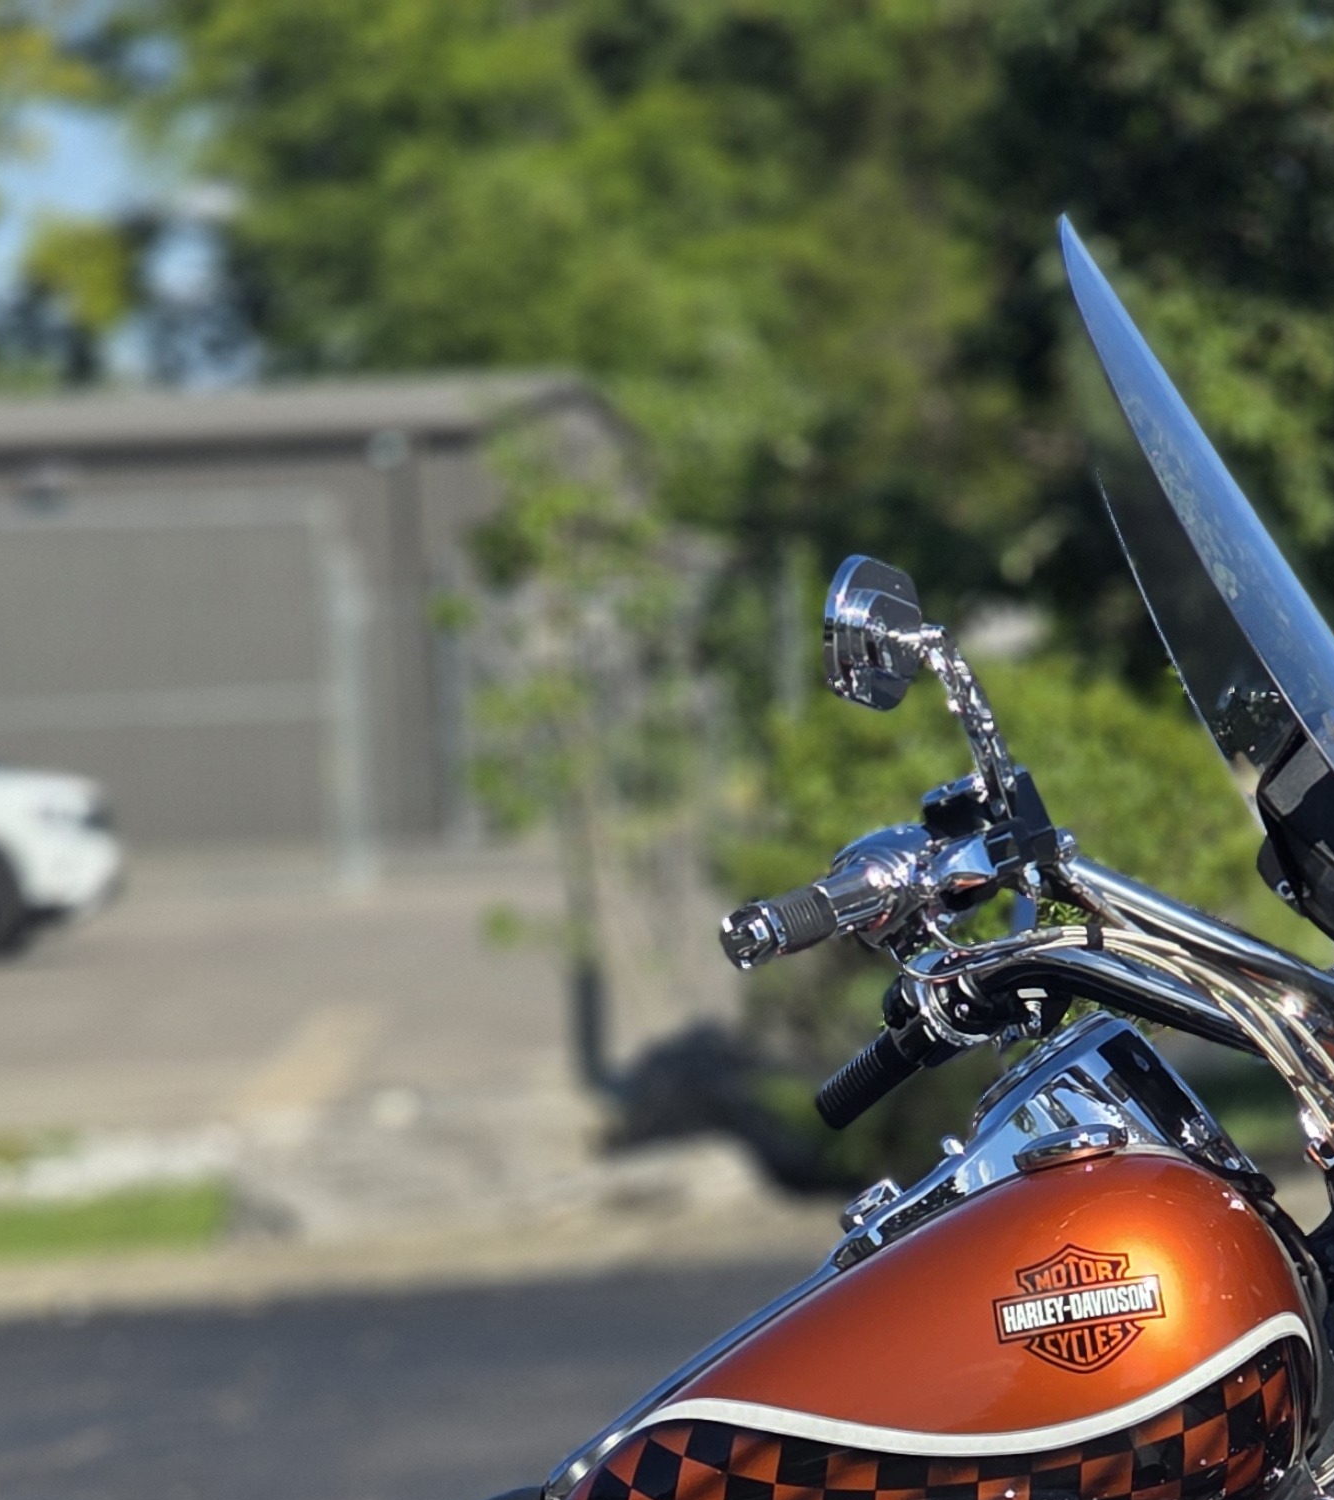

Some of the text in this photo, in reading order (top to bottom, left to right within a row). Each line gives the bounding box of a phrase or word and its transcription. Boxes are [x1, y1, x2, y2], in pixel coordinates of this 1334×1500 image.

[1034, 1257, 1114, 1290] MOTOR
[1002, 1281, 1155, 1333] HARLEY-DAVIDSON
[1043, 1326, 1122, 1364] CYCLES
